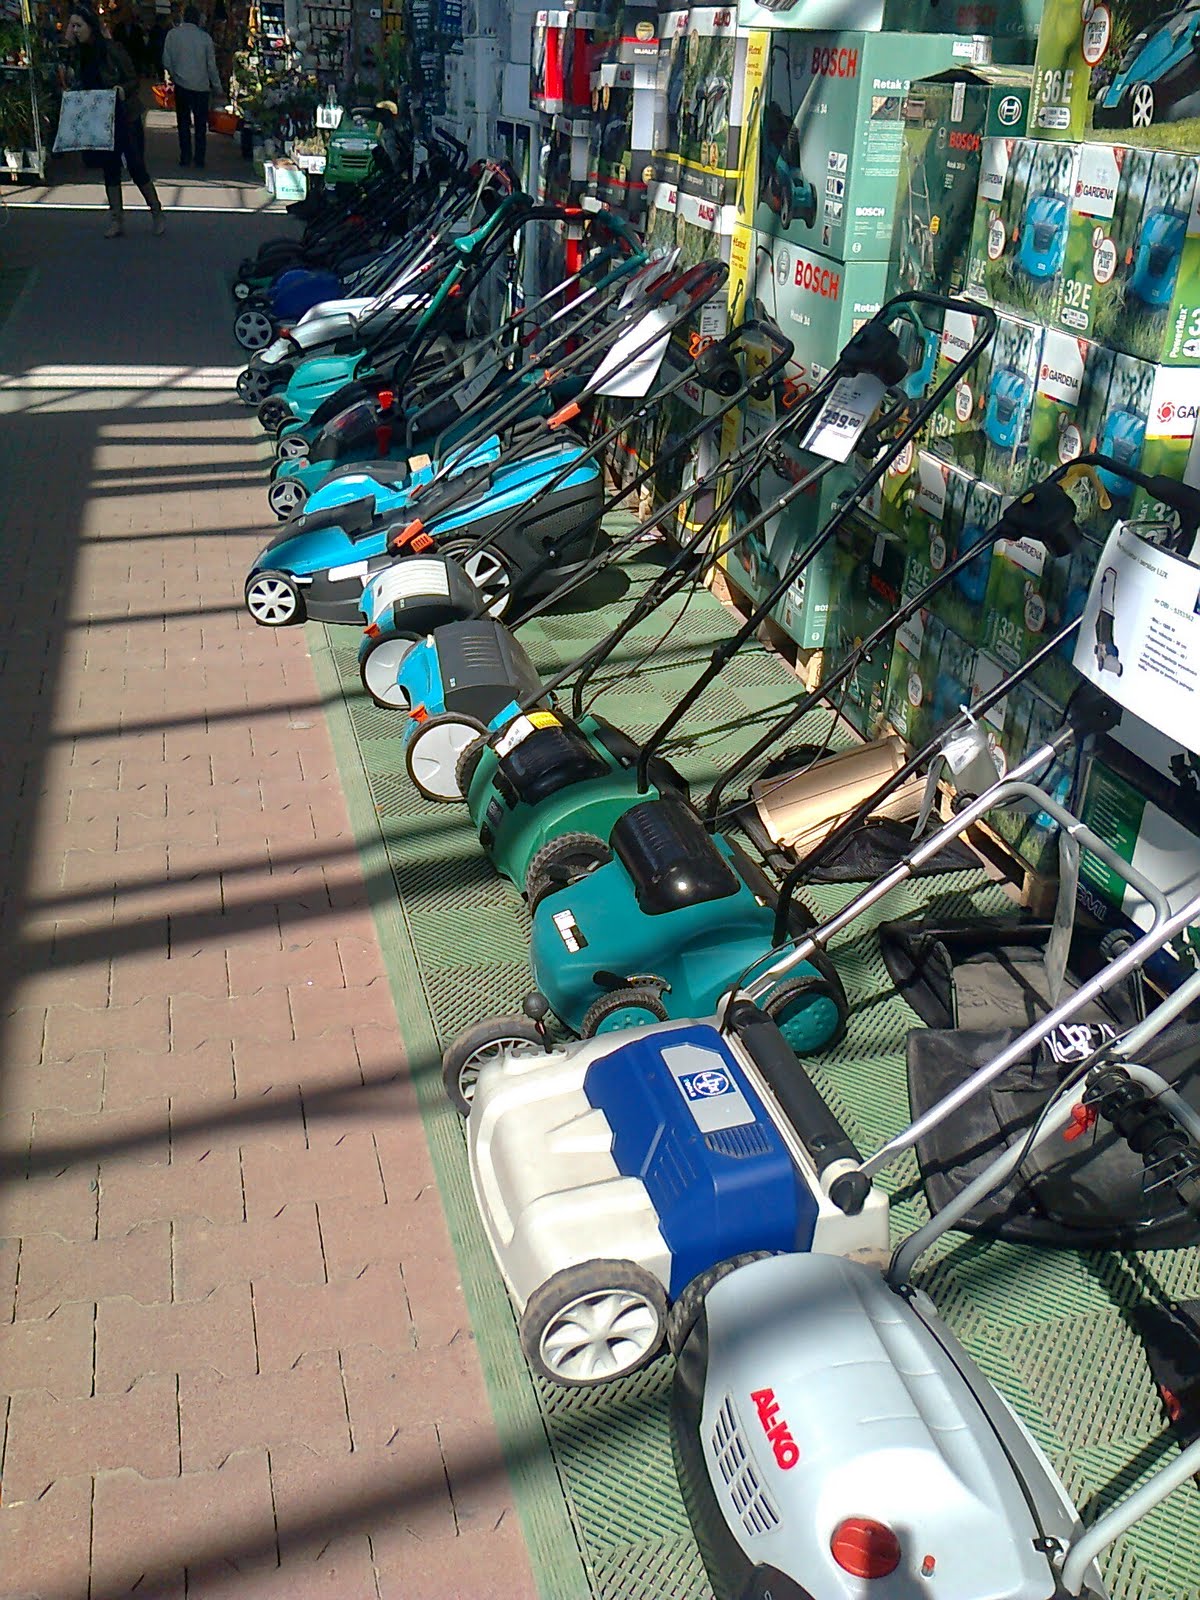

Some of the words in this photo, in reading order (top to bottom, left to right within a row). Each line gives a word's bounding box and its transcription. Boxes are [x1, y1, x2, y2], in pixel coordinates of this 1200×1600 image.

[811, 47, 859, 78] BOSCH
[1083, 185, 1114, 200] GARDENA
[855, 207, 885, 217] BOSCH
[795, 260, 840, 301] BOSCH
[1049, 370, 1079, 389] GARDENA
[751, 1388, 800, 1470] AL-KO
